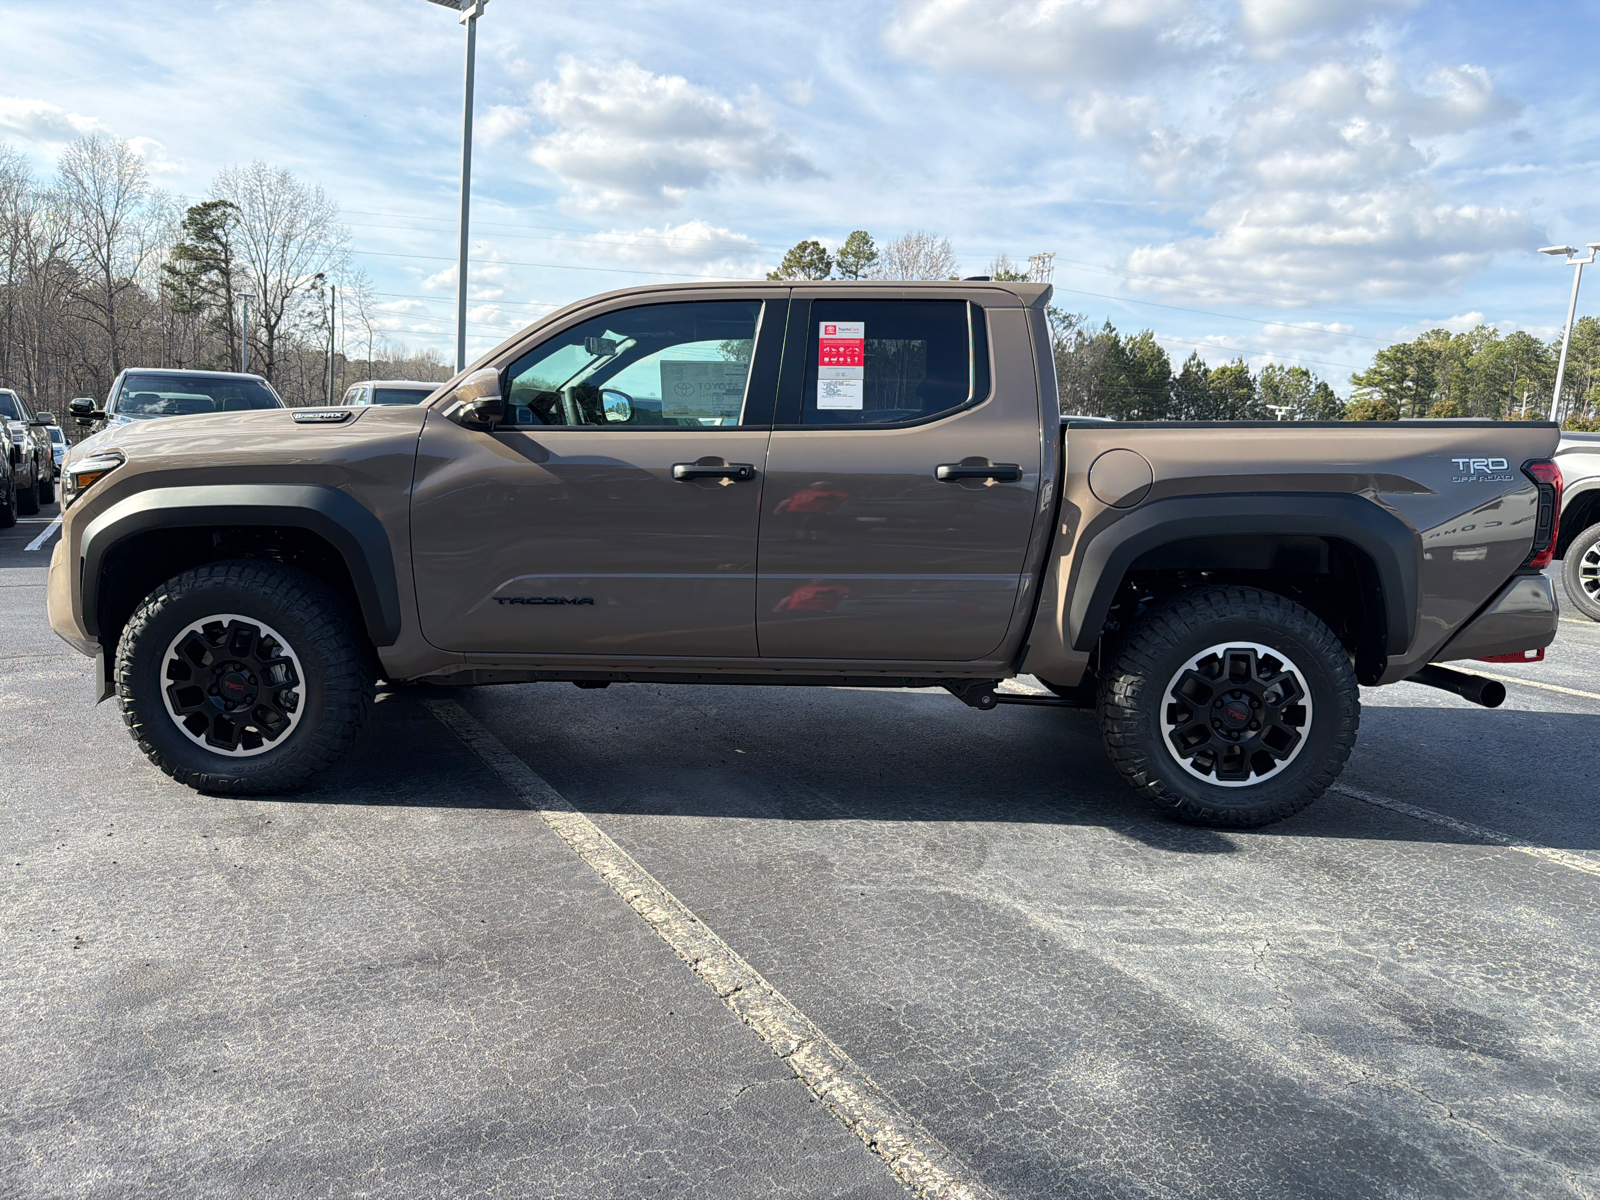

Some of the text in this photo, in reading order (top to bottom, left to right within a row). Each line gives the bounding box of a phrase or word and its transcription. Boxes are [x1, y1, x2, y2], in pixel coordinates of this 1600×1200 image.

[697, 382, 739, 391] TOYOTA
[1451, 458, 1509, 474] TRD
[492, 596, 595, 605] TACOMA
[225, 681, 244, 690] TRD
[1228, 709, 1247, 720] TRD
